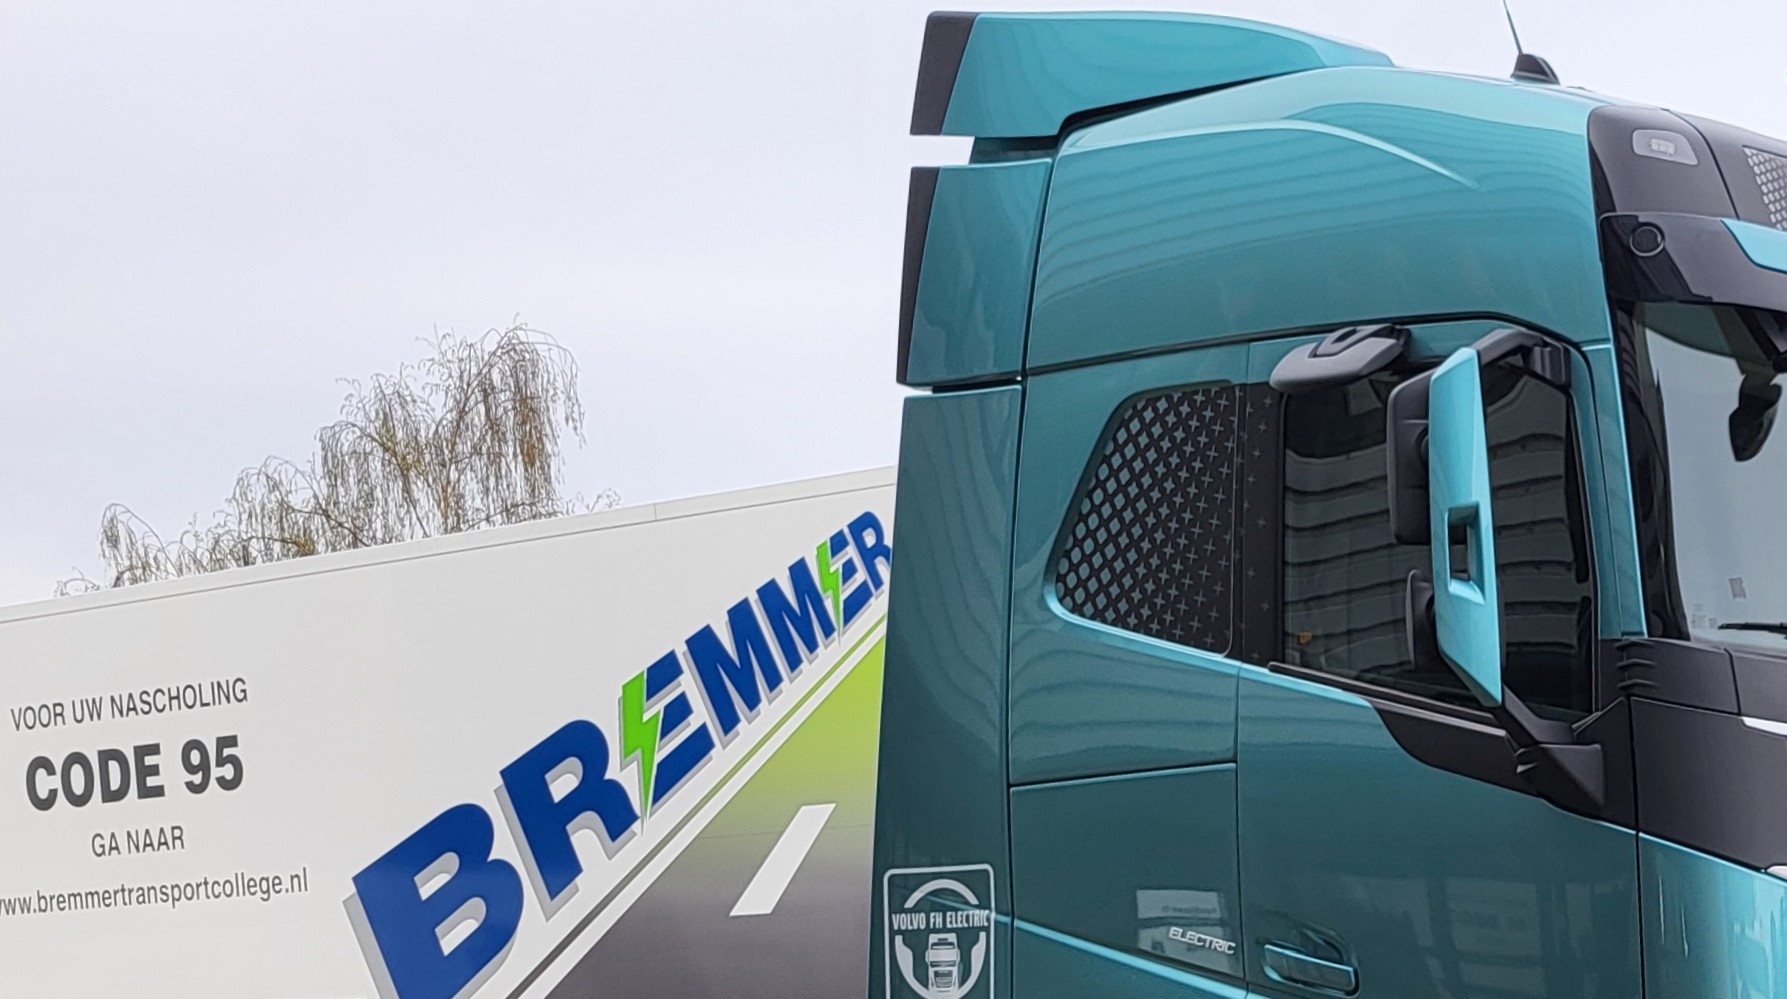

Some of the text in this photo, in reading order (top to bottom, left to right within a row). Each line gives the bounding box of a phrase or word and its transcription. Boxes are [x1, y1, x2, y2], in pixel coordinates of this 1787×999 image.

[11, 677, 248, 731] VOOR UW NASCHOLING
[26, 734, 244, 811] CODE 95
[91, 825, 185, 857] GA NAAR
[0, 866, 309, 917] ww.bremmertransportcollege.nl
[892, 909, 990, 931] VOLVO FH ELECTRIC
[1168, 926, 1236, 954] ELECTRIC
